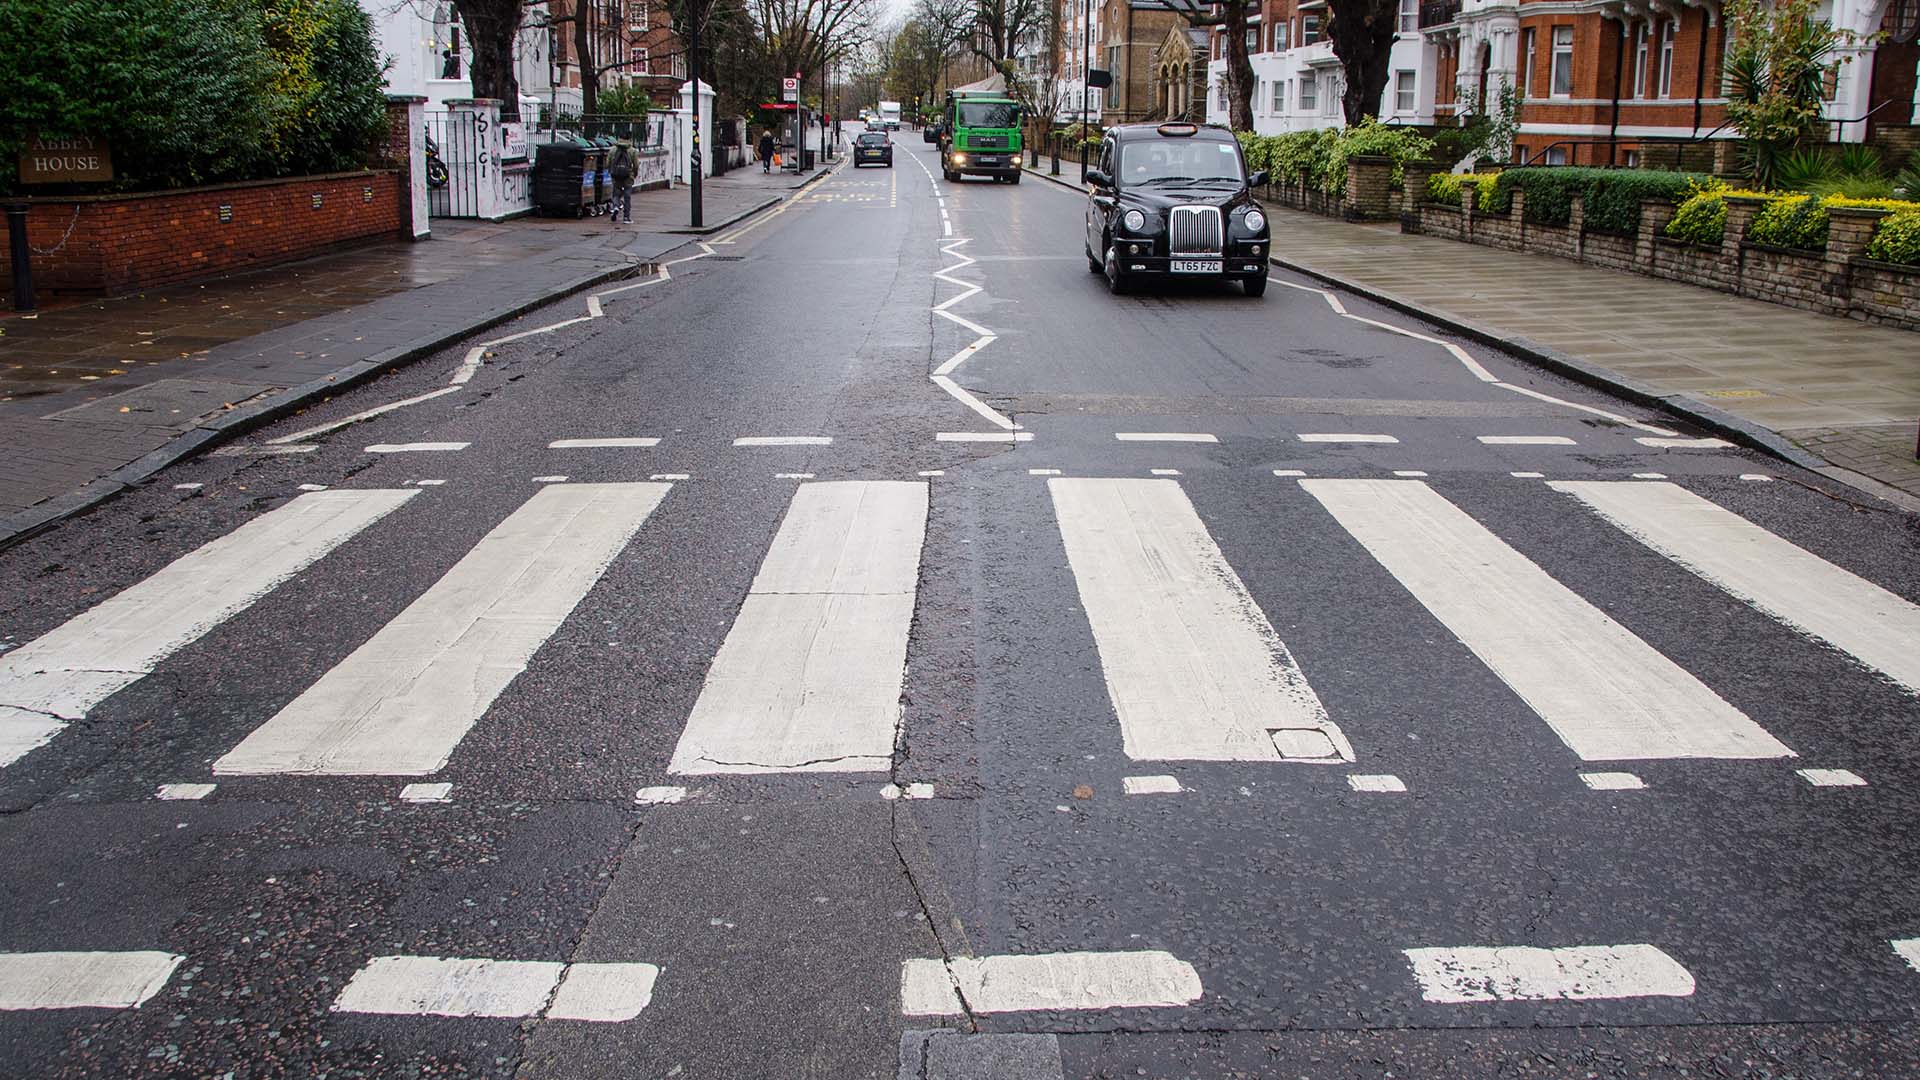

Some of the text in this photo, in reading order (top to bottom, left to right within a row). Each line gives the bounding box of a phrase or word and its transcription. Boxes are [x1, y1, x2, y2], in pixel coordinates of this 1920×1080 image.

[32, 135, 97, 150] ABBEY
[33, 156, 100, 172] HOUSE
[1174, 261, 1219, 271] LT65 FZC
